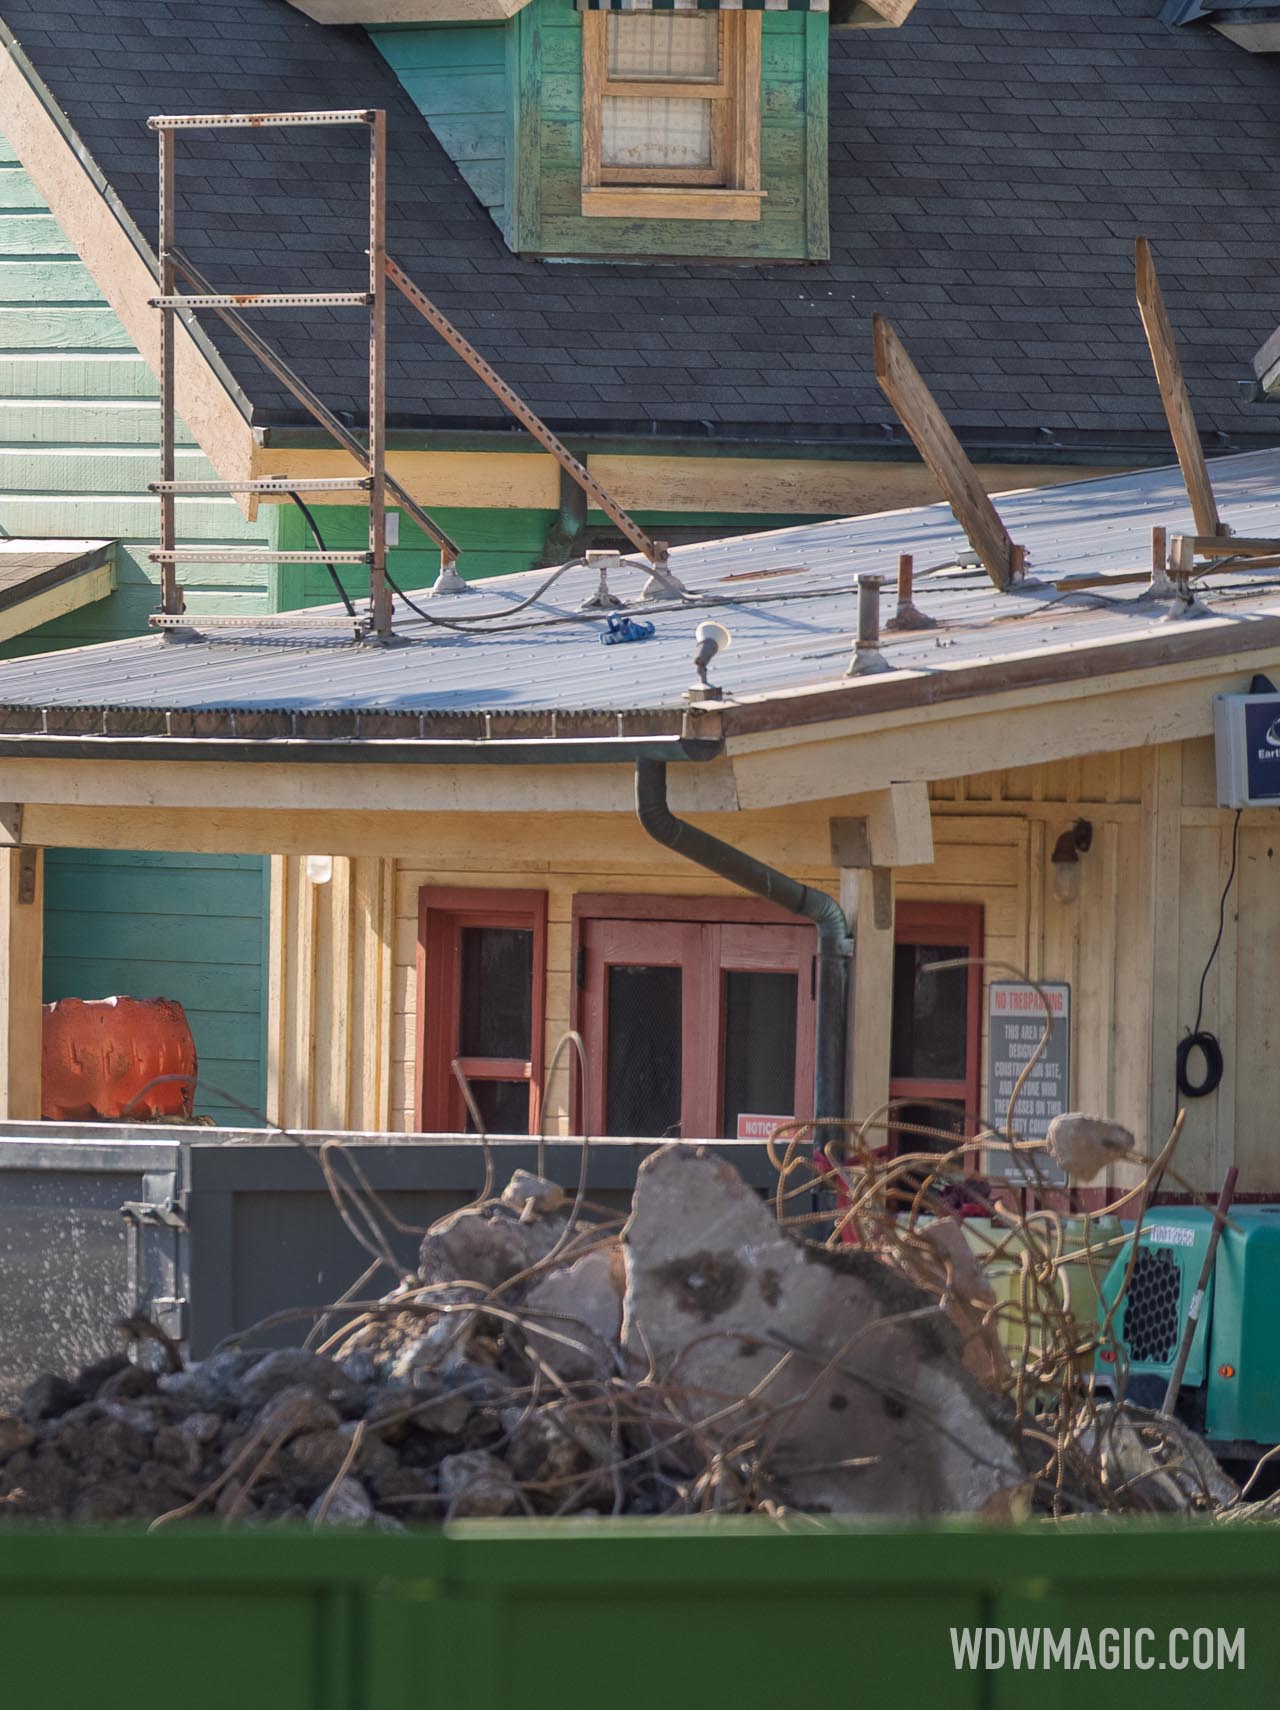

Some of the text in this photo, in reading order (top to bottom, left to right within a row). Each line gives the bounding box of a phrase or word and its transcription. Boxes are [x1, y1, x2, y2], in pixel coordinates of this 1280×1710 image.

[1258, 748, 1280, 759] Eart
[995, 992, 1006, 1009] NO
[1004, 1024, 1019, 1040] THIS
[1021, 1025, 1037, 1040] AREA
[1041, 1082, 1057, 1097] WHO
[1035, 1100, 1046, 1115] ON
[1047, 1101, 1062, 1116] THIS
